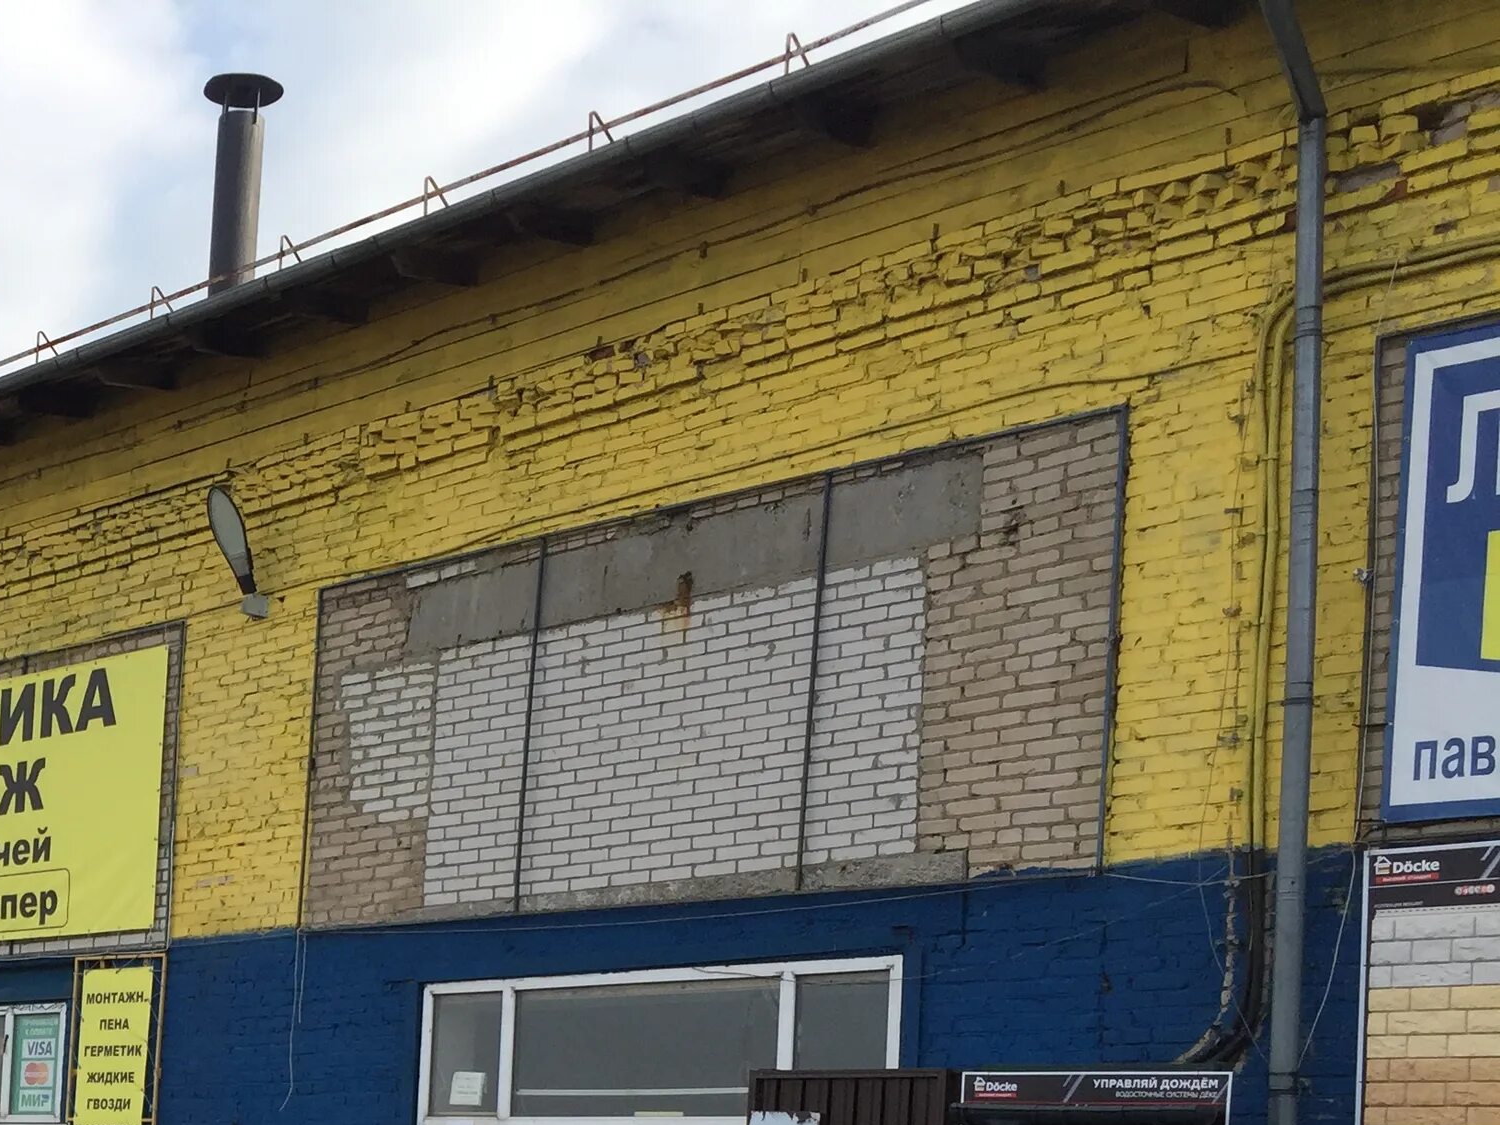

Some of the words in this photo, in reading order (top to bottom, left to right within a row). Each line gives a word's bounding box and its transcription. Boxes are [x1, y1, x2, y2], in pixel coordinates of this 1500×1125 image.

[1413, 735, 1496, 781] пав
[1392, 860, 1440, 874] Döcke
[99, 1018, 130, 1031] ПЕНА
[27, 1041, 52, 1056] VISA
[84, 1044, 143, 1057] ГЕРМЕТИК
[86, 1071, 135, 1084] ЖИДКИЕ
[1092, 1077, 1158, 1090] УПРАВЛЯЙ
[1160, 1077, 1219, 1091] ДОЖДЁМ
[986, 1081, 1018, 1092] Döcke
[21, 1094, 50, 1107] МИР
[86, 1098, 131, 1111] ГВОЗДИ
